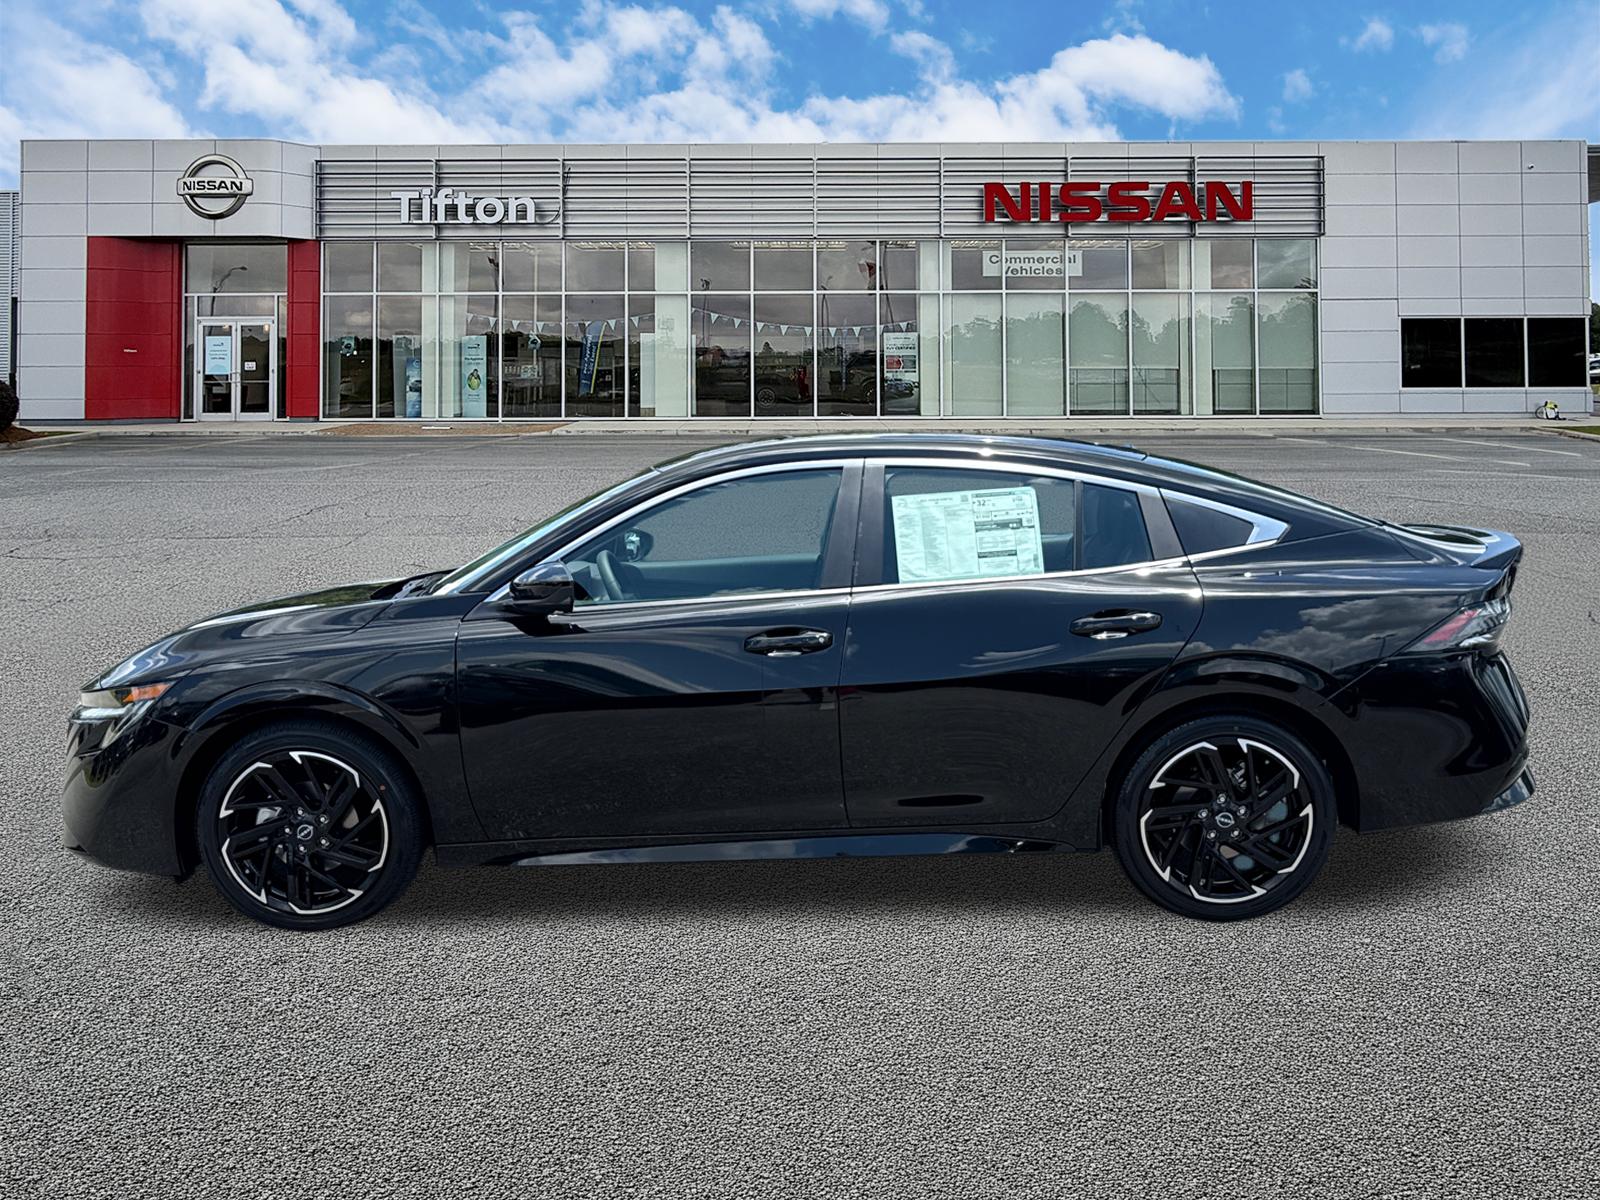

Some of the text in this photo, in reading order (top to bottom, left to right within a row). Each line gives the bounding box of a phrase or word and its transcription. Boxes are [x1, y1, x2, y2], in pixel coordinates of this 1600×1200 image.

[183, 180, 243, 191] NISSAN
[983, 181, 1253, 222] NISSAN
[391, 188, 536, 224] Tifton
